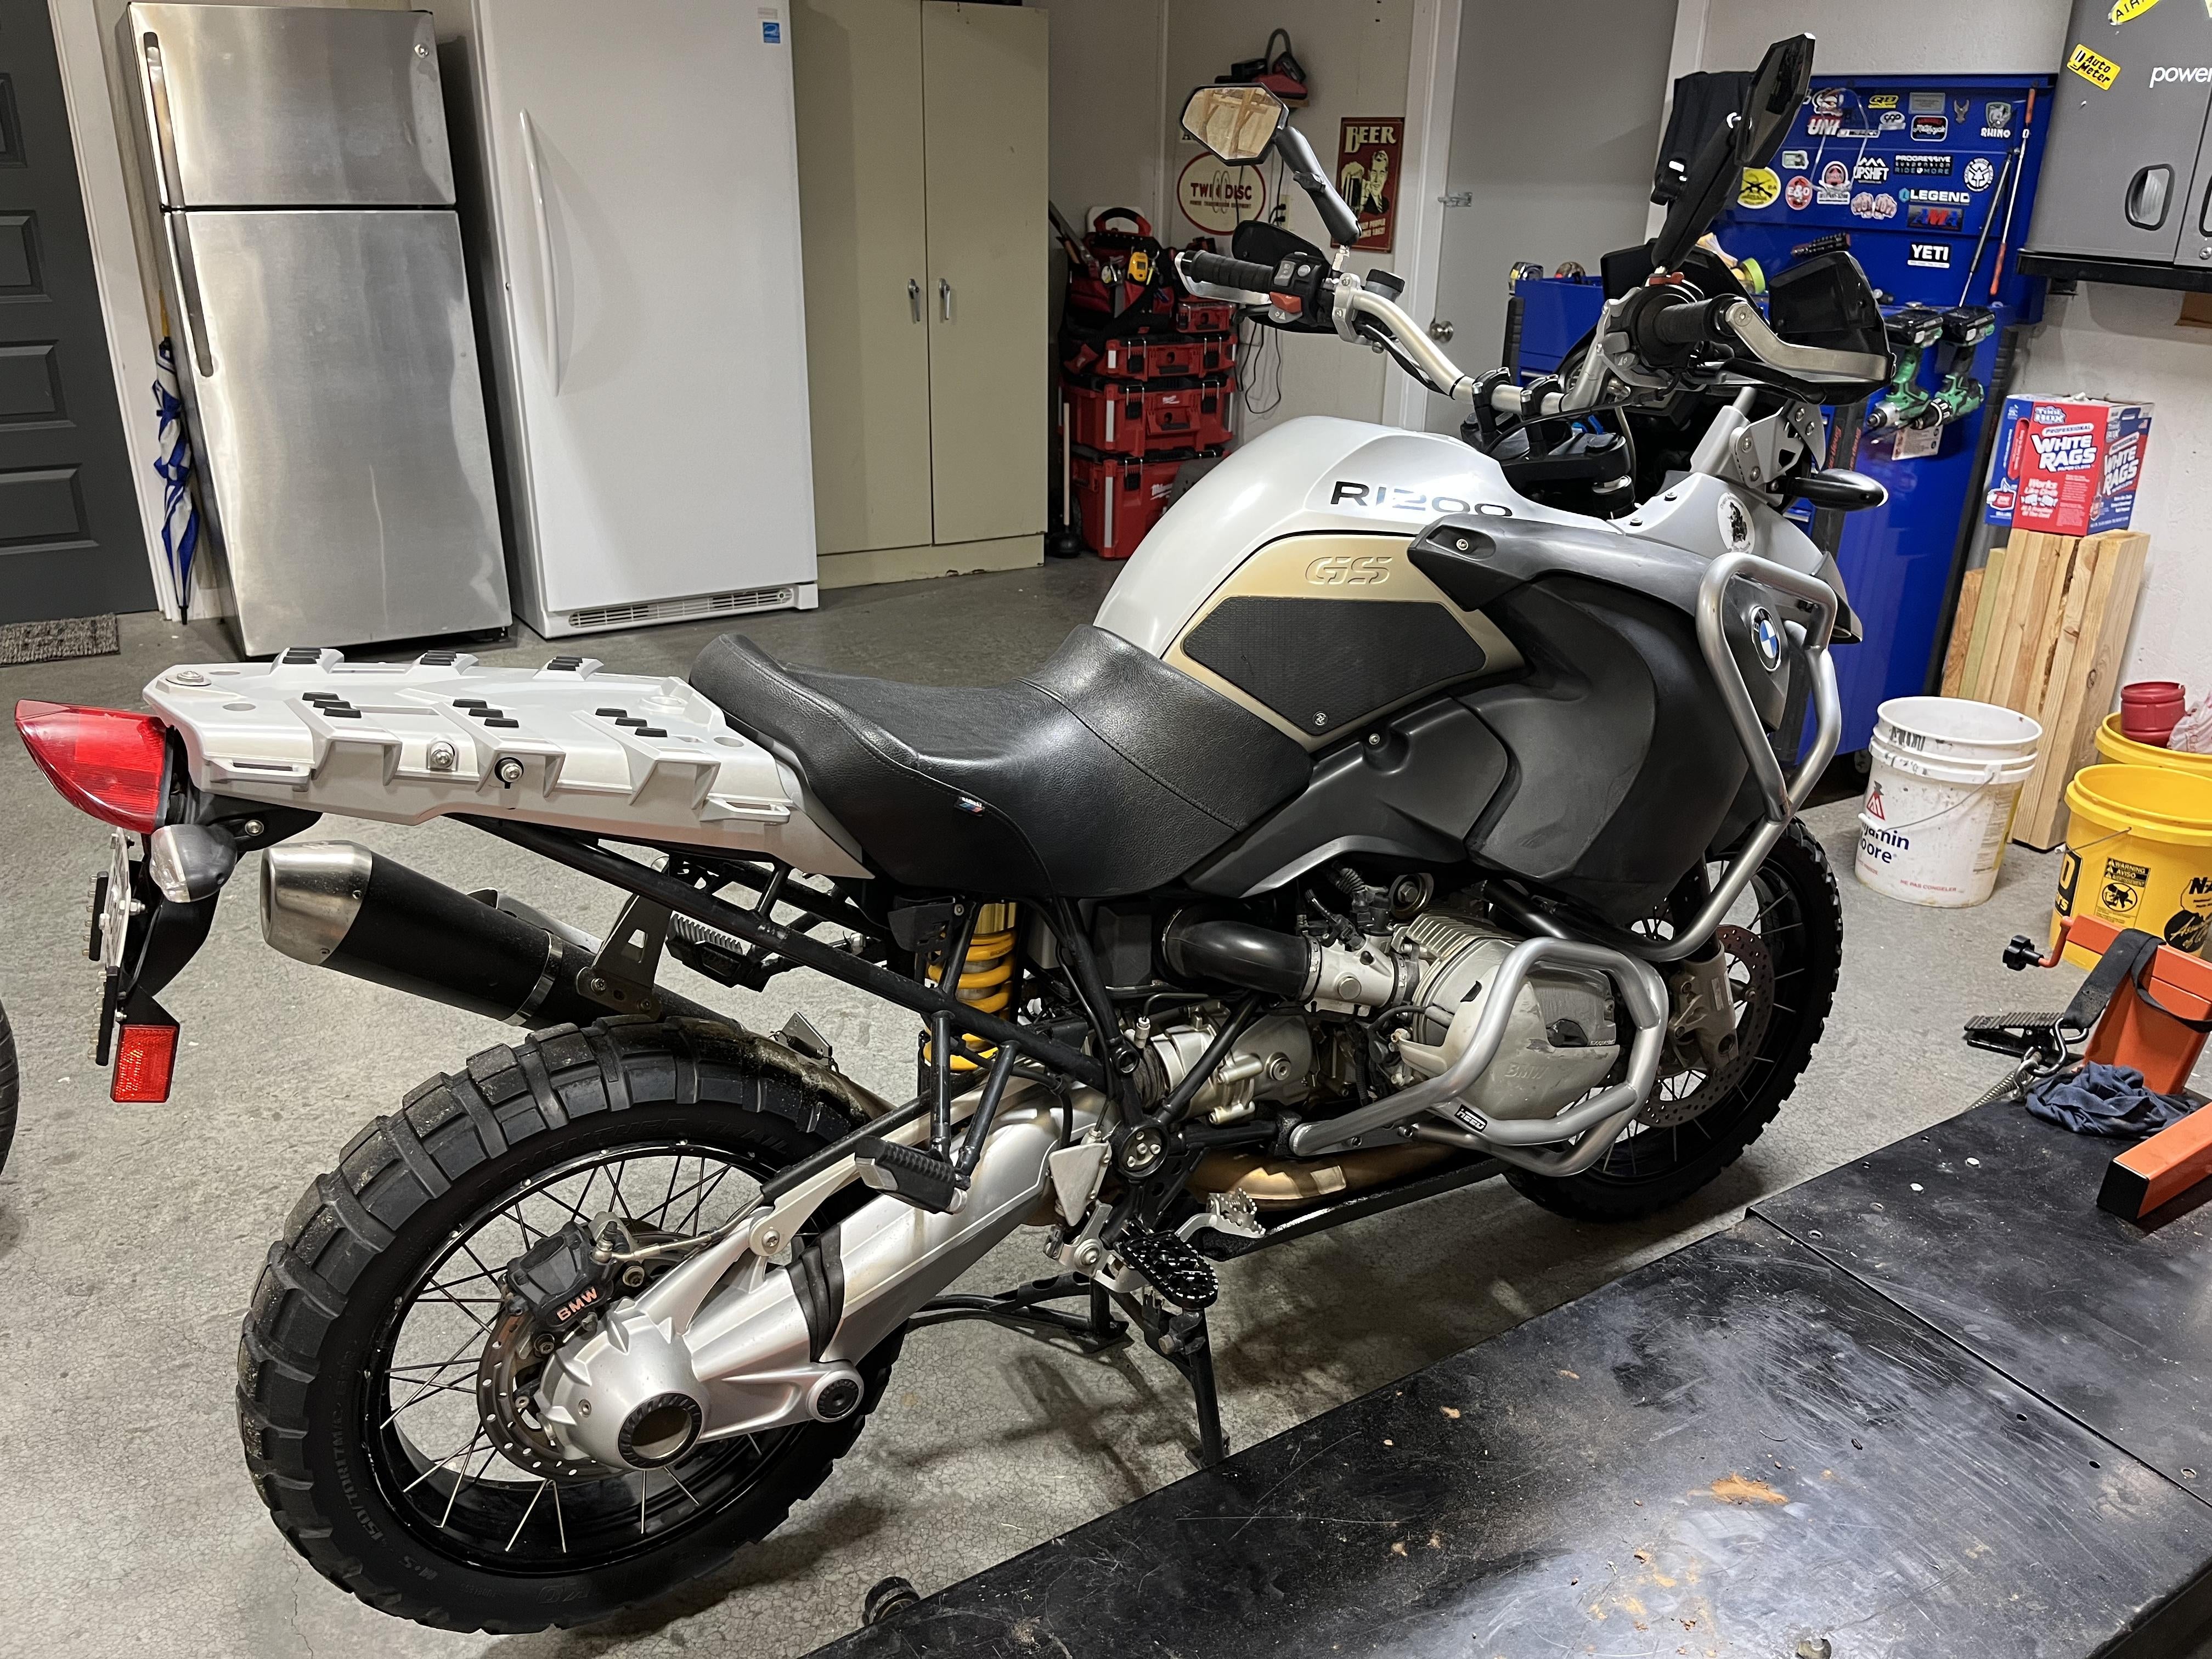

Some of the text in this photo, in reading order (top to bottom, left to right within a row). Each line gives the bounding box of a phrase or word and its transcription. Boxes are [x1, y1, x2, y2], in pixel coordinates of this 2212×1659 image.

[2079, 63, 2111, 84] Meter
[2085, 54, 2111, 74] Auto
[1344, 126, 1397, 153] BEER
[1980, 127, 2011, 138] RHINO
[1910, 189, 1971, 204] LEGEND
[1911, 244, 1950, 261] YETI
[2031, 434, 2093, 454] WHITE
[2039, 447, 2097, 472] RAGS
[2104, 445, 2137, 475] WHITE
[2102, 459, 2139, 496] RAGS
[1330, 481, 1513, 517] R1200
[1305, 556, 1393, 585] GS
[2115, 861, 2146, 874] WARNING
[2117, 868, 2137, 879] AVISO
[556, 1285, 598, 1322] BMW
